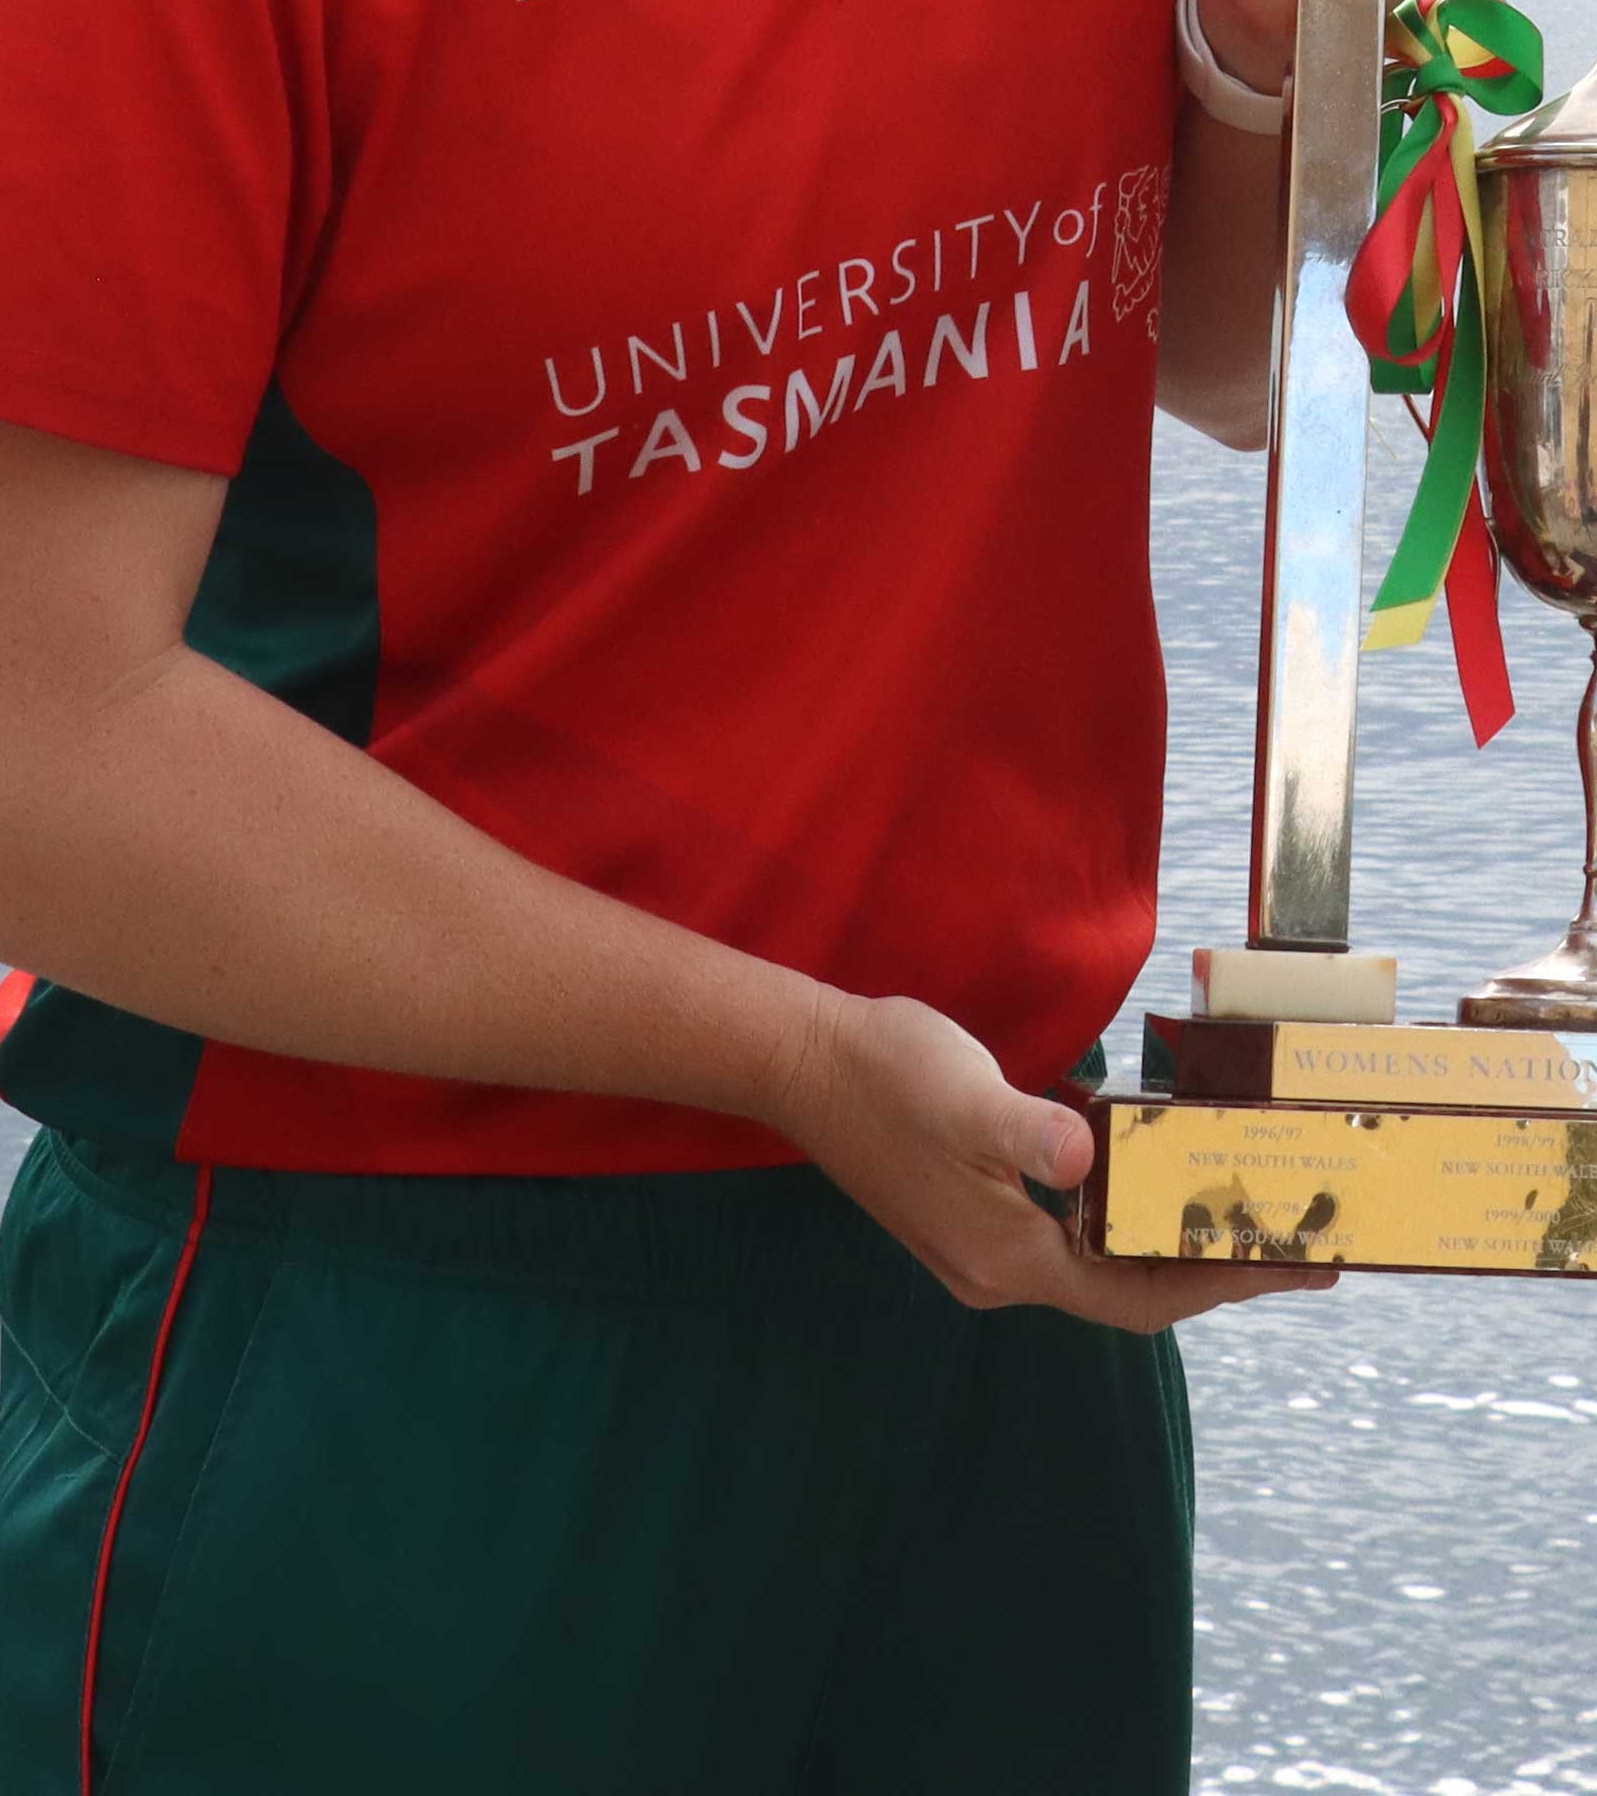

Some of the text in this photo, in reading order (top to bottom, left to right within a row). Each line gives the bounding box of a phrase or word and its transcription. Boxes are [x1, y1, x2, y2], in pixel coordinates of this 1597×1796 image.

[545, 181, 1107, 417] UNIVERSITY of
[552, 278, 1091, 496] TASMANIA
[1294, 1050, 1448, 1077] WOMENS
[1244, 1125, 1302, 1141] 1996/97
[1496, 1134, 1555, 1149] 1998/99
[1188, 1153, 1357, 1170] NEW SOUTH WALES
[1441, 1161, 1480, 1174] NEW
[1487, 1162, 1547, 1176] SOUTH
[1485, 1208, 1561, 1225] 1999/2000
[1186, 1228, 1353, 1245] NEW SOUTH WALES
[1438, 1236, 1477, 1249] NEW
[1483, 1237, 1543, 1252] SOUTH
